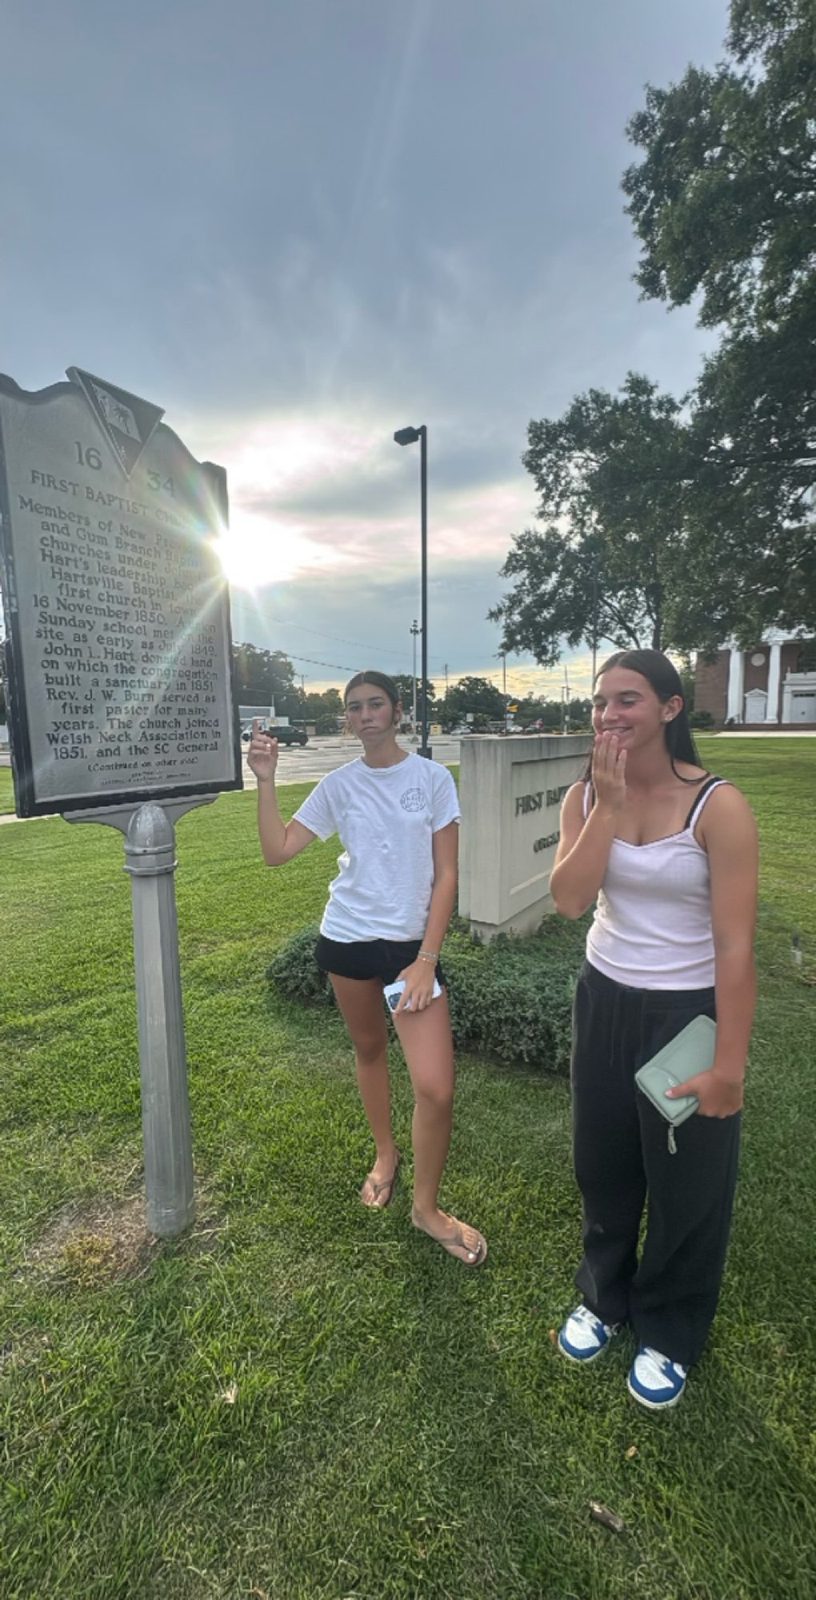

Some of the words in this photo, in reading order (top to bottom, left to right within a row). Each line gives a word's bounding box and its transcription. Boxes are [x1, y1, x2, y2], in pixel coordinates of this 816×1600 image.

[74, 441, 103, 471] 16
[147, 468, 176, 497] 34
[31, 469, 80, 496] FIRST
[85, 486, 148, 517] BAPTIST
[18, 494, 90, 526] Members
[98, 520, 113, 534] of
[120, 523, 146, 540] New
[41, 520, 70, 537] and
[76, 527, 108, 546] Gum
[115, 536, 161, 558] Branch
[40, 534, 111, 561] churches
[118, 553, 157, 572] under
[40, 548, 89, 571] Hart's
[51, 566, 125, 591] Hartsville
[33, 594, 50, 608] 16
[56, 597, 130, 620] November
[136, 610, 168, 626] 1850.
[57, 582, 90, 600] first
[98, 591, 146, 609] church
[151, 600, 162, 612] in
[35, 626, 64, 641] site
[73, 632, 88, 643] as
[97, 634, 134, 650] early
[141, 640, 154, 650] as
[38, 611, 96, 632] Sunday
[103, 621, 147, 637] school
[153, 628, 175, 640] met
[44, 641, 83, 658] John
[87, 646, 100, 659] L.
[191, 657, 213, 668] land
[40, 659, 59, 670] on
[65, 659, 109, 674] which
[114, 661, 136, 675] the
[141, 666, 218, 681] congregation
[44, 672, 82, 687] built
[91, 677, 100, 688] a
[105, 677, 171, 692] sanctuary
[176, 681, 187, 692] in
[46, 687, 79, 701] Rev.
[84, 688, 96, 701] J.
[101, 689, 117, 702] W.
[125, 689, 154, 702] Burn
[162, 692, 200, 703] served
[205, 694, 216, 703] as
[61, 702, 94, 715] first
[105, 704, 149, 717] pastor
[154, 703, 173, 716] for
[177, 706, 208, 718] many
[46, 732, 93, 746] Welsh
[98, 730, 133, 744] Neck
[138, 729, 208, 743] Association
[211, 729, 221, 740] in
[51, 719, 99, 732] years.
[106, 717, 134, 730] The
[139, 717, 181, 730] church
[185, 718, 220, 731] joined
[96, 745, 121, 758] and
[128, 744, 150, 756] the
[154, 742, 170, 755] SC
[176, 741, 218, 754] General
[514, 791, 545, 818] FIRST
